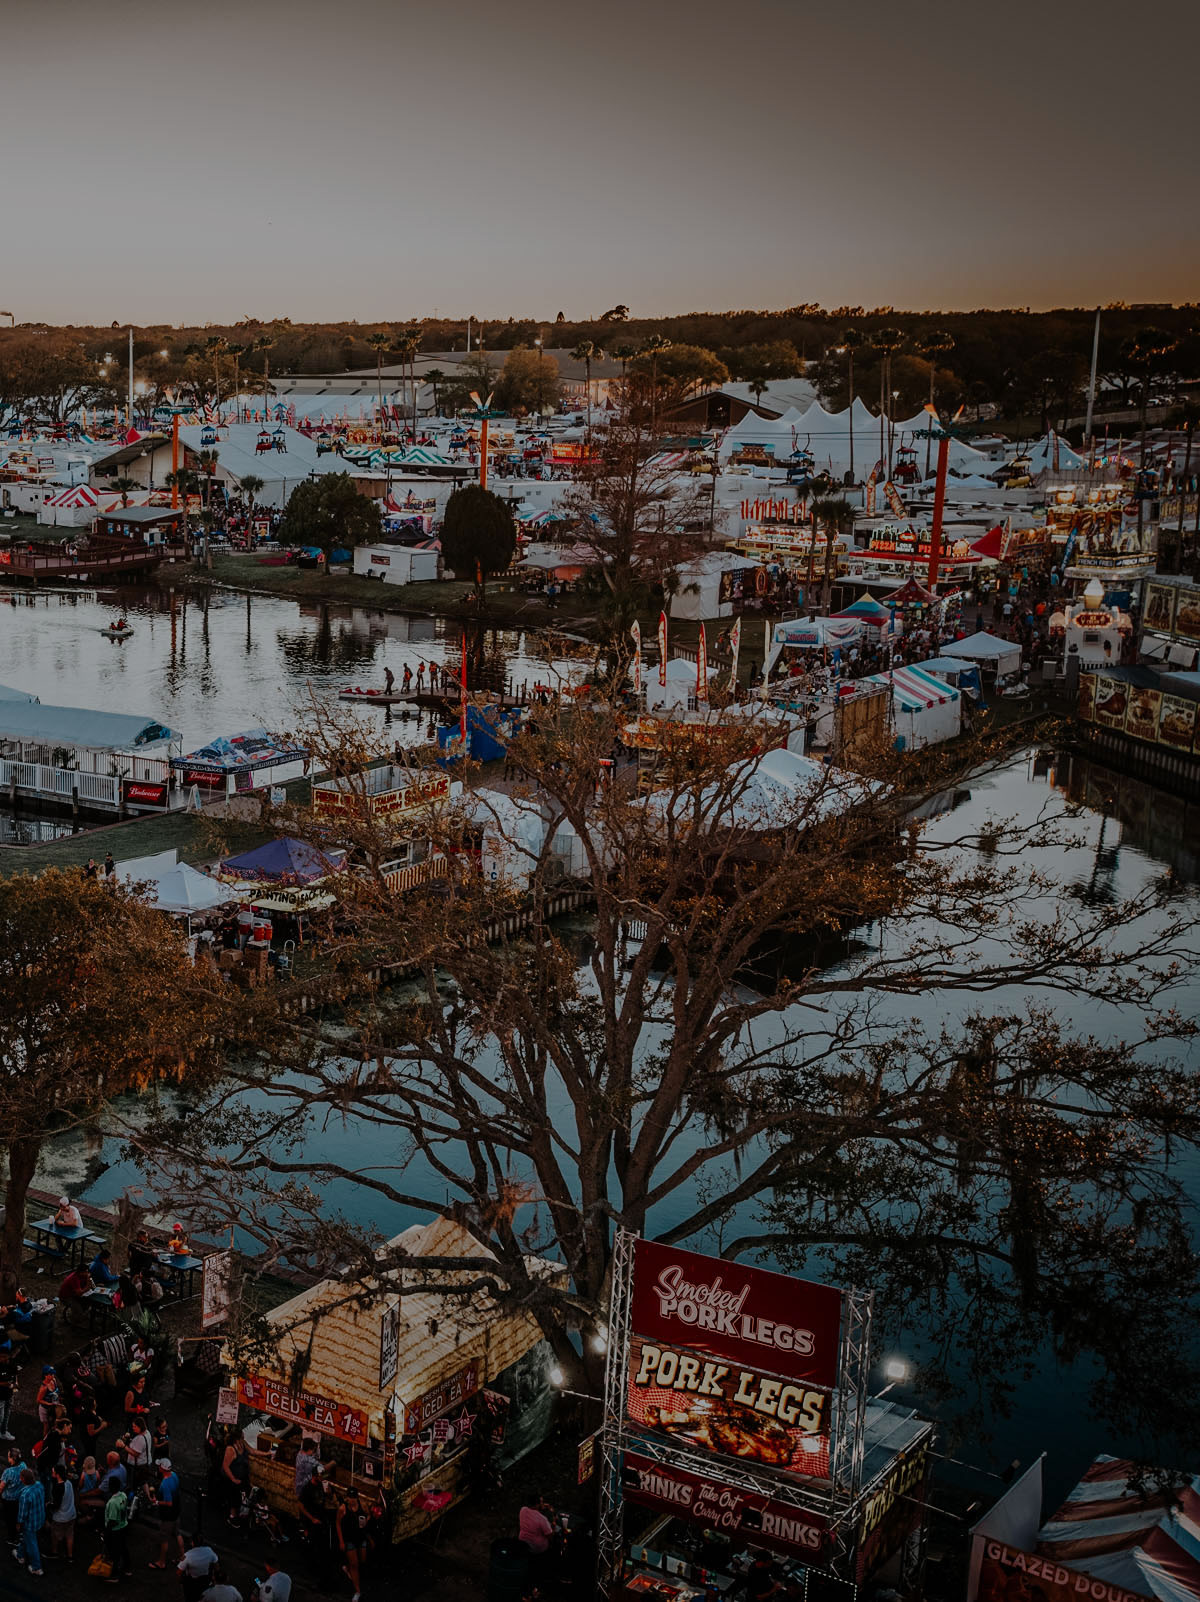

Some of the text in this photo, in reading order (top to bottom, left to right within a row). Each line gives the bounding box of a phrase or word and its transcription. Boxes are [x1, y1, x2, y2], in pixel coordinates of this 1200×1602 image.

[129, 786, 161, 799] Budweiser
[190, 771, 221, 784] Budweiser
[249, 889, 297, 904] PANTING
[652, 1265, 750, 1313] Smoked
[660, 1299, 816, 1357] PORK LEGS
[265, 1380, 296, 1397] FRES
[635, 1344, 826, 1434] PORK LEGS
[265, 1389, 301, 1415] ICED
[305, 1403, 335, 1428] EA
[422, 1395, 443, 1420] ICED
[627, 1467, 694, 1508] RINKS
[698, 1482, 743, 1509] Take Out
[692, 1501, 743, 1530] Carry Out
[745, 1506, 822, 1551] RINKS
[986, 1542, 1070, 1586] GLAZED
